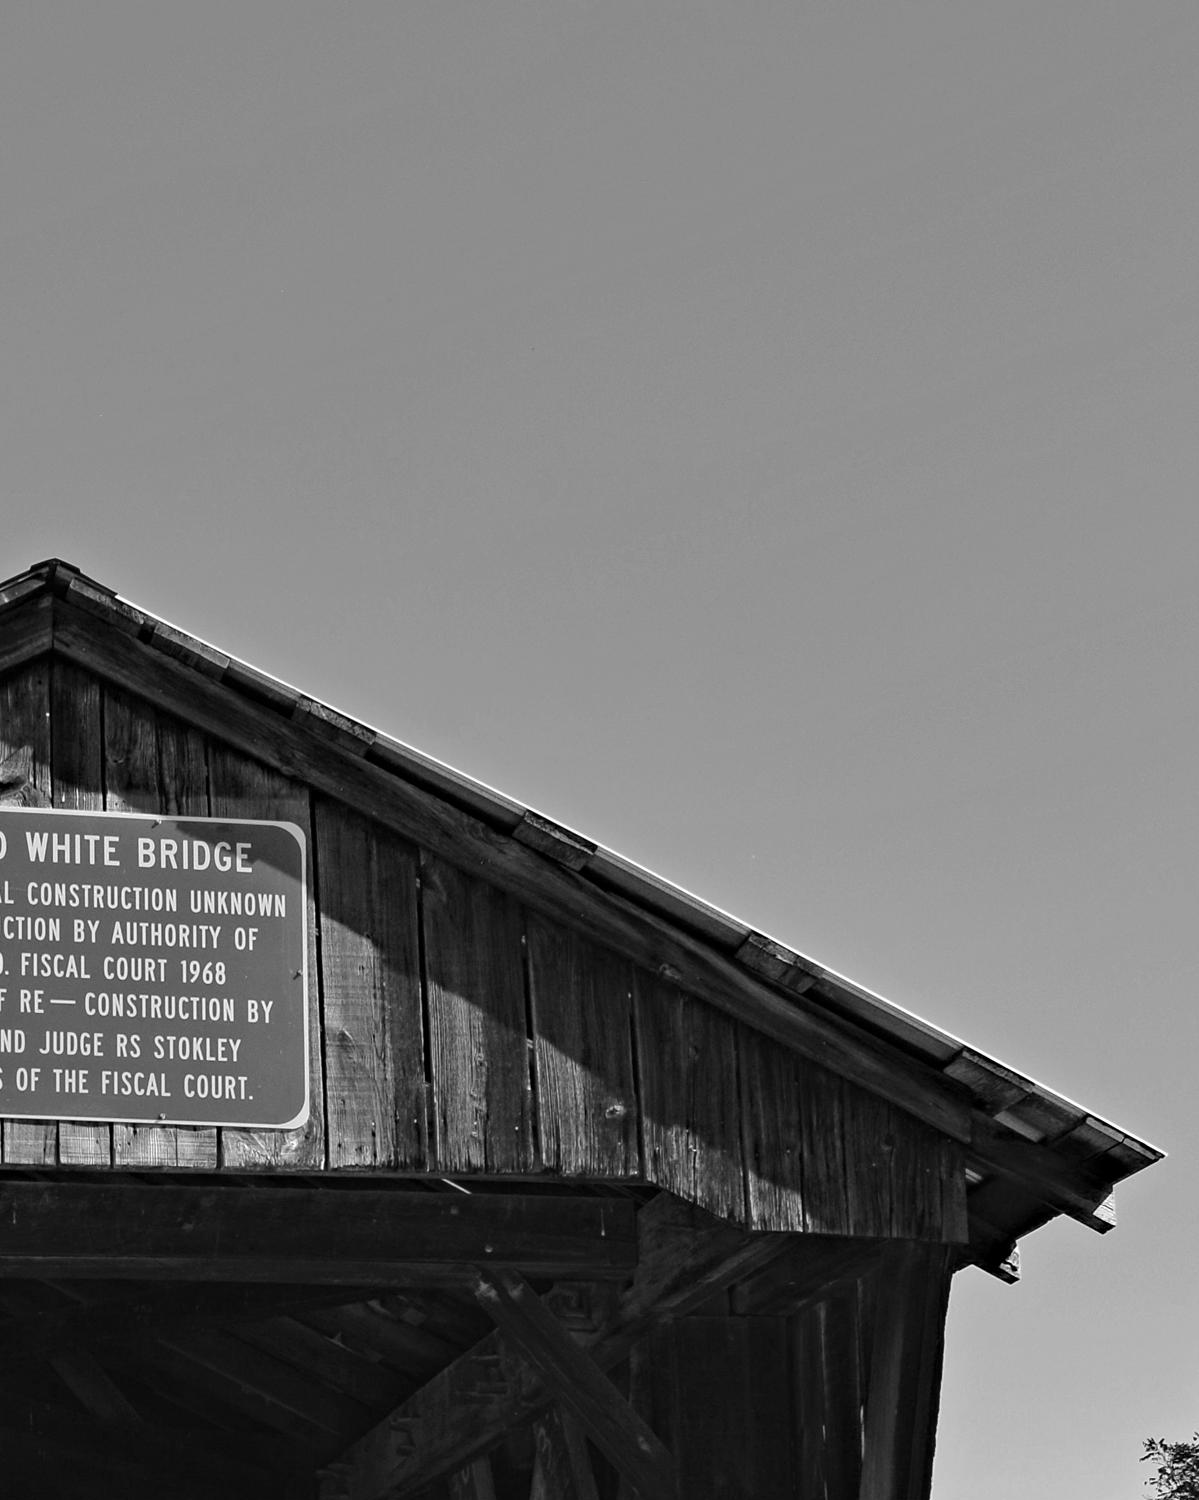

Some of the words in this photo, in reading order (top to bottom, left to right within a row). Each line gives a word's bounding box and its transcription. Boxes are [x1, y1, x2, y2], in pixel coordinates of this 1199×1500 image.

[25, 831, 121, 867] WHITE
[137, 837, 253, 873] BRIDGE
[27, 881, 177, 913] CONSTRUCTION
[190, 889, 286, 918] UNKNOWN
[73, 918, 100, 944] BY
[111, 920, 222, 949] AUTHORITY
[234, 926, 259, 951] OF
[20, 952, 91, 979] FISCAL
[103, 956, 168, 983] COURT
[180, 959, 226, 986] 1968
[247, 999, 274, 1024] BY
[38, 1030, 104, 1057] JUDGE
[116, 1033, 141, 1059] RS
[153, 1035, 242, 1063] STOKLEY
[15, 1067, 41, 1092] OF
[52, 1068, 89, 1094] THE
[101, 1070, 172, 1097] FISCAL
[183, 1073, 254, 1101] COURT.
